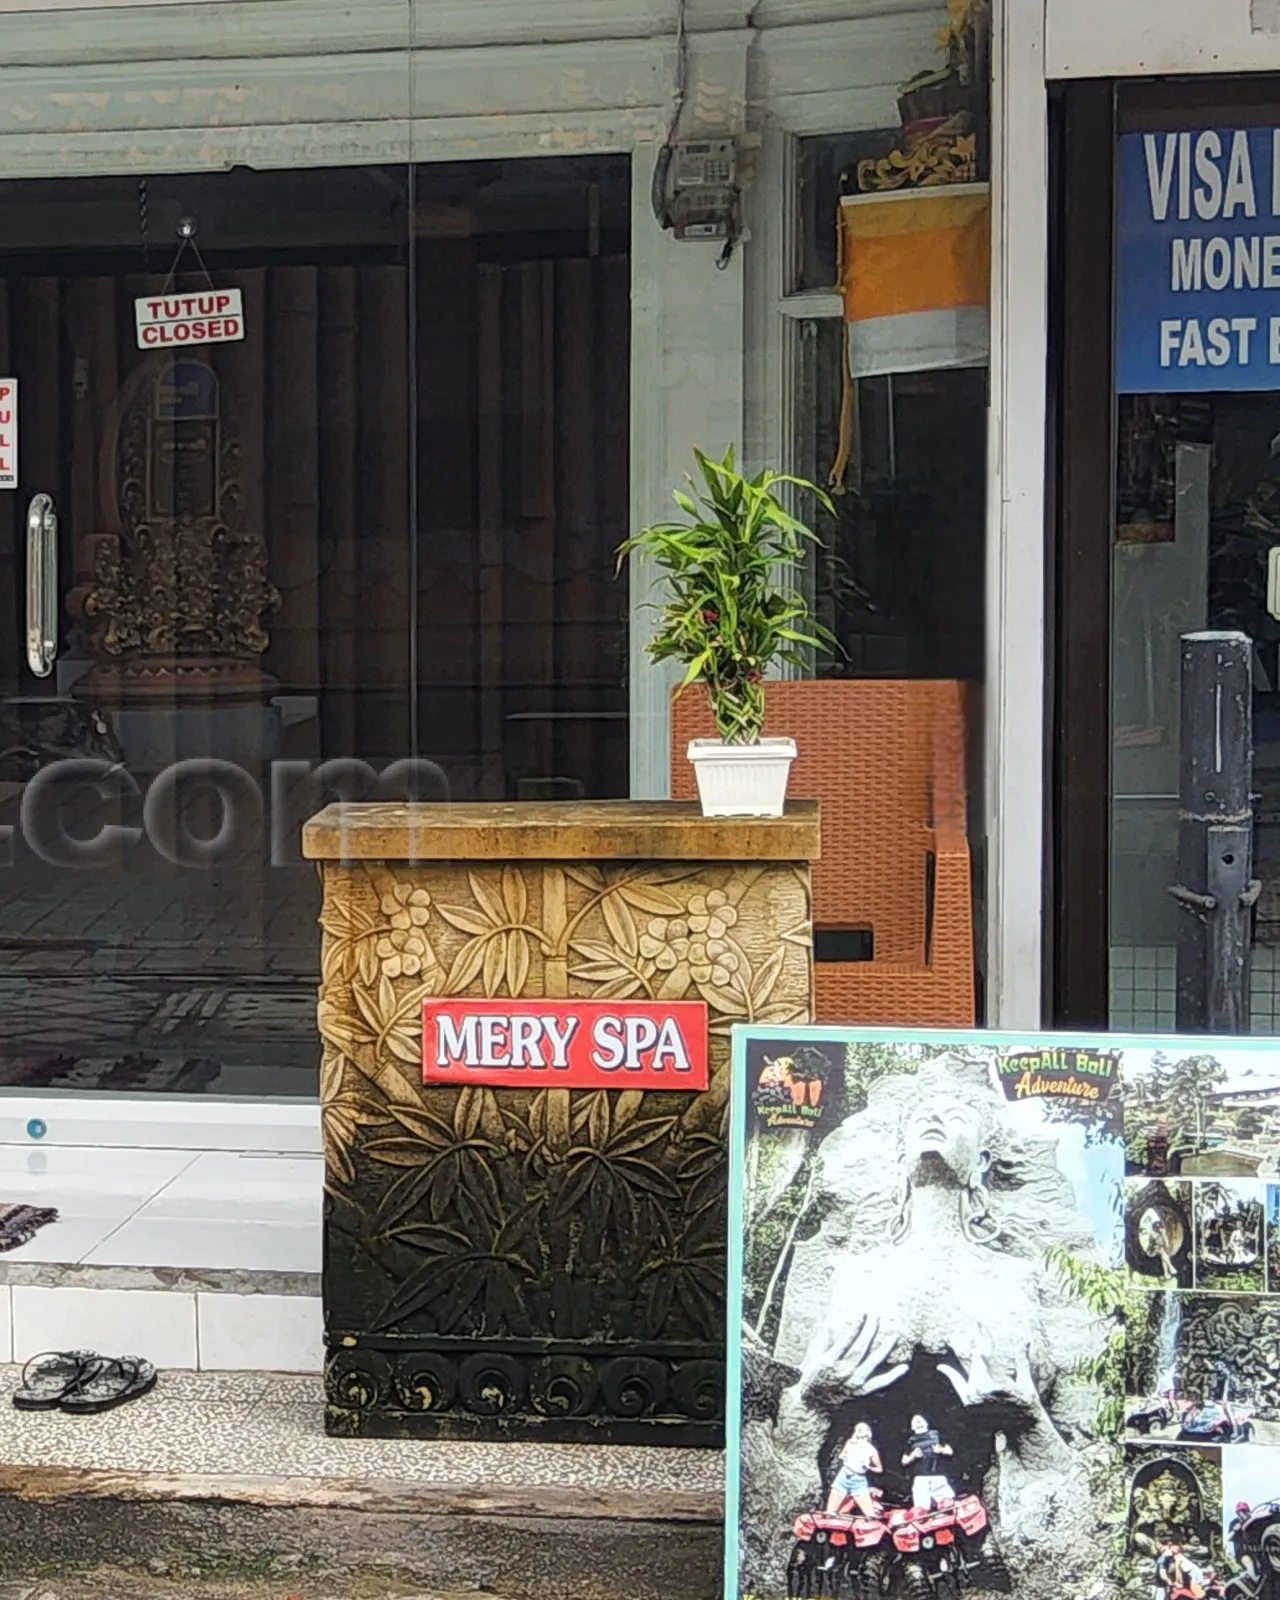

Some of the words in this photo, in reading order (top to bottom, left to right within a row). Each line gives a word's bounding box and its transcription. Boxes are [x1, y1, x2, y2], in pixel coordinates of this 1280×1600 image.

[1143, 130, 1257, 220] VISA
[1171, 236, 1280, 291] MONE
[142, 319, 239, 344] CLOSED
[147, 295, 231, 319] TUTUP
[1160, 317, 1257, 367] FAST
[435, 1015, 579, 1068] MERY
[592, 1015, 691, 1070] SPA
[1014, 1071, 1100, 1099] Adventure
